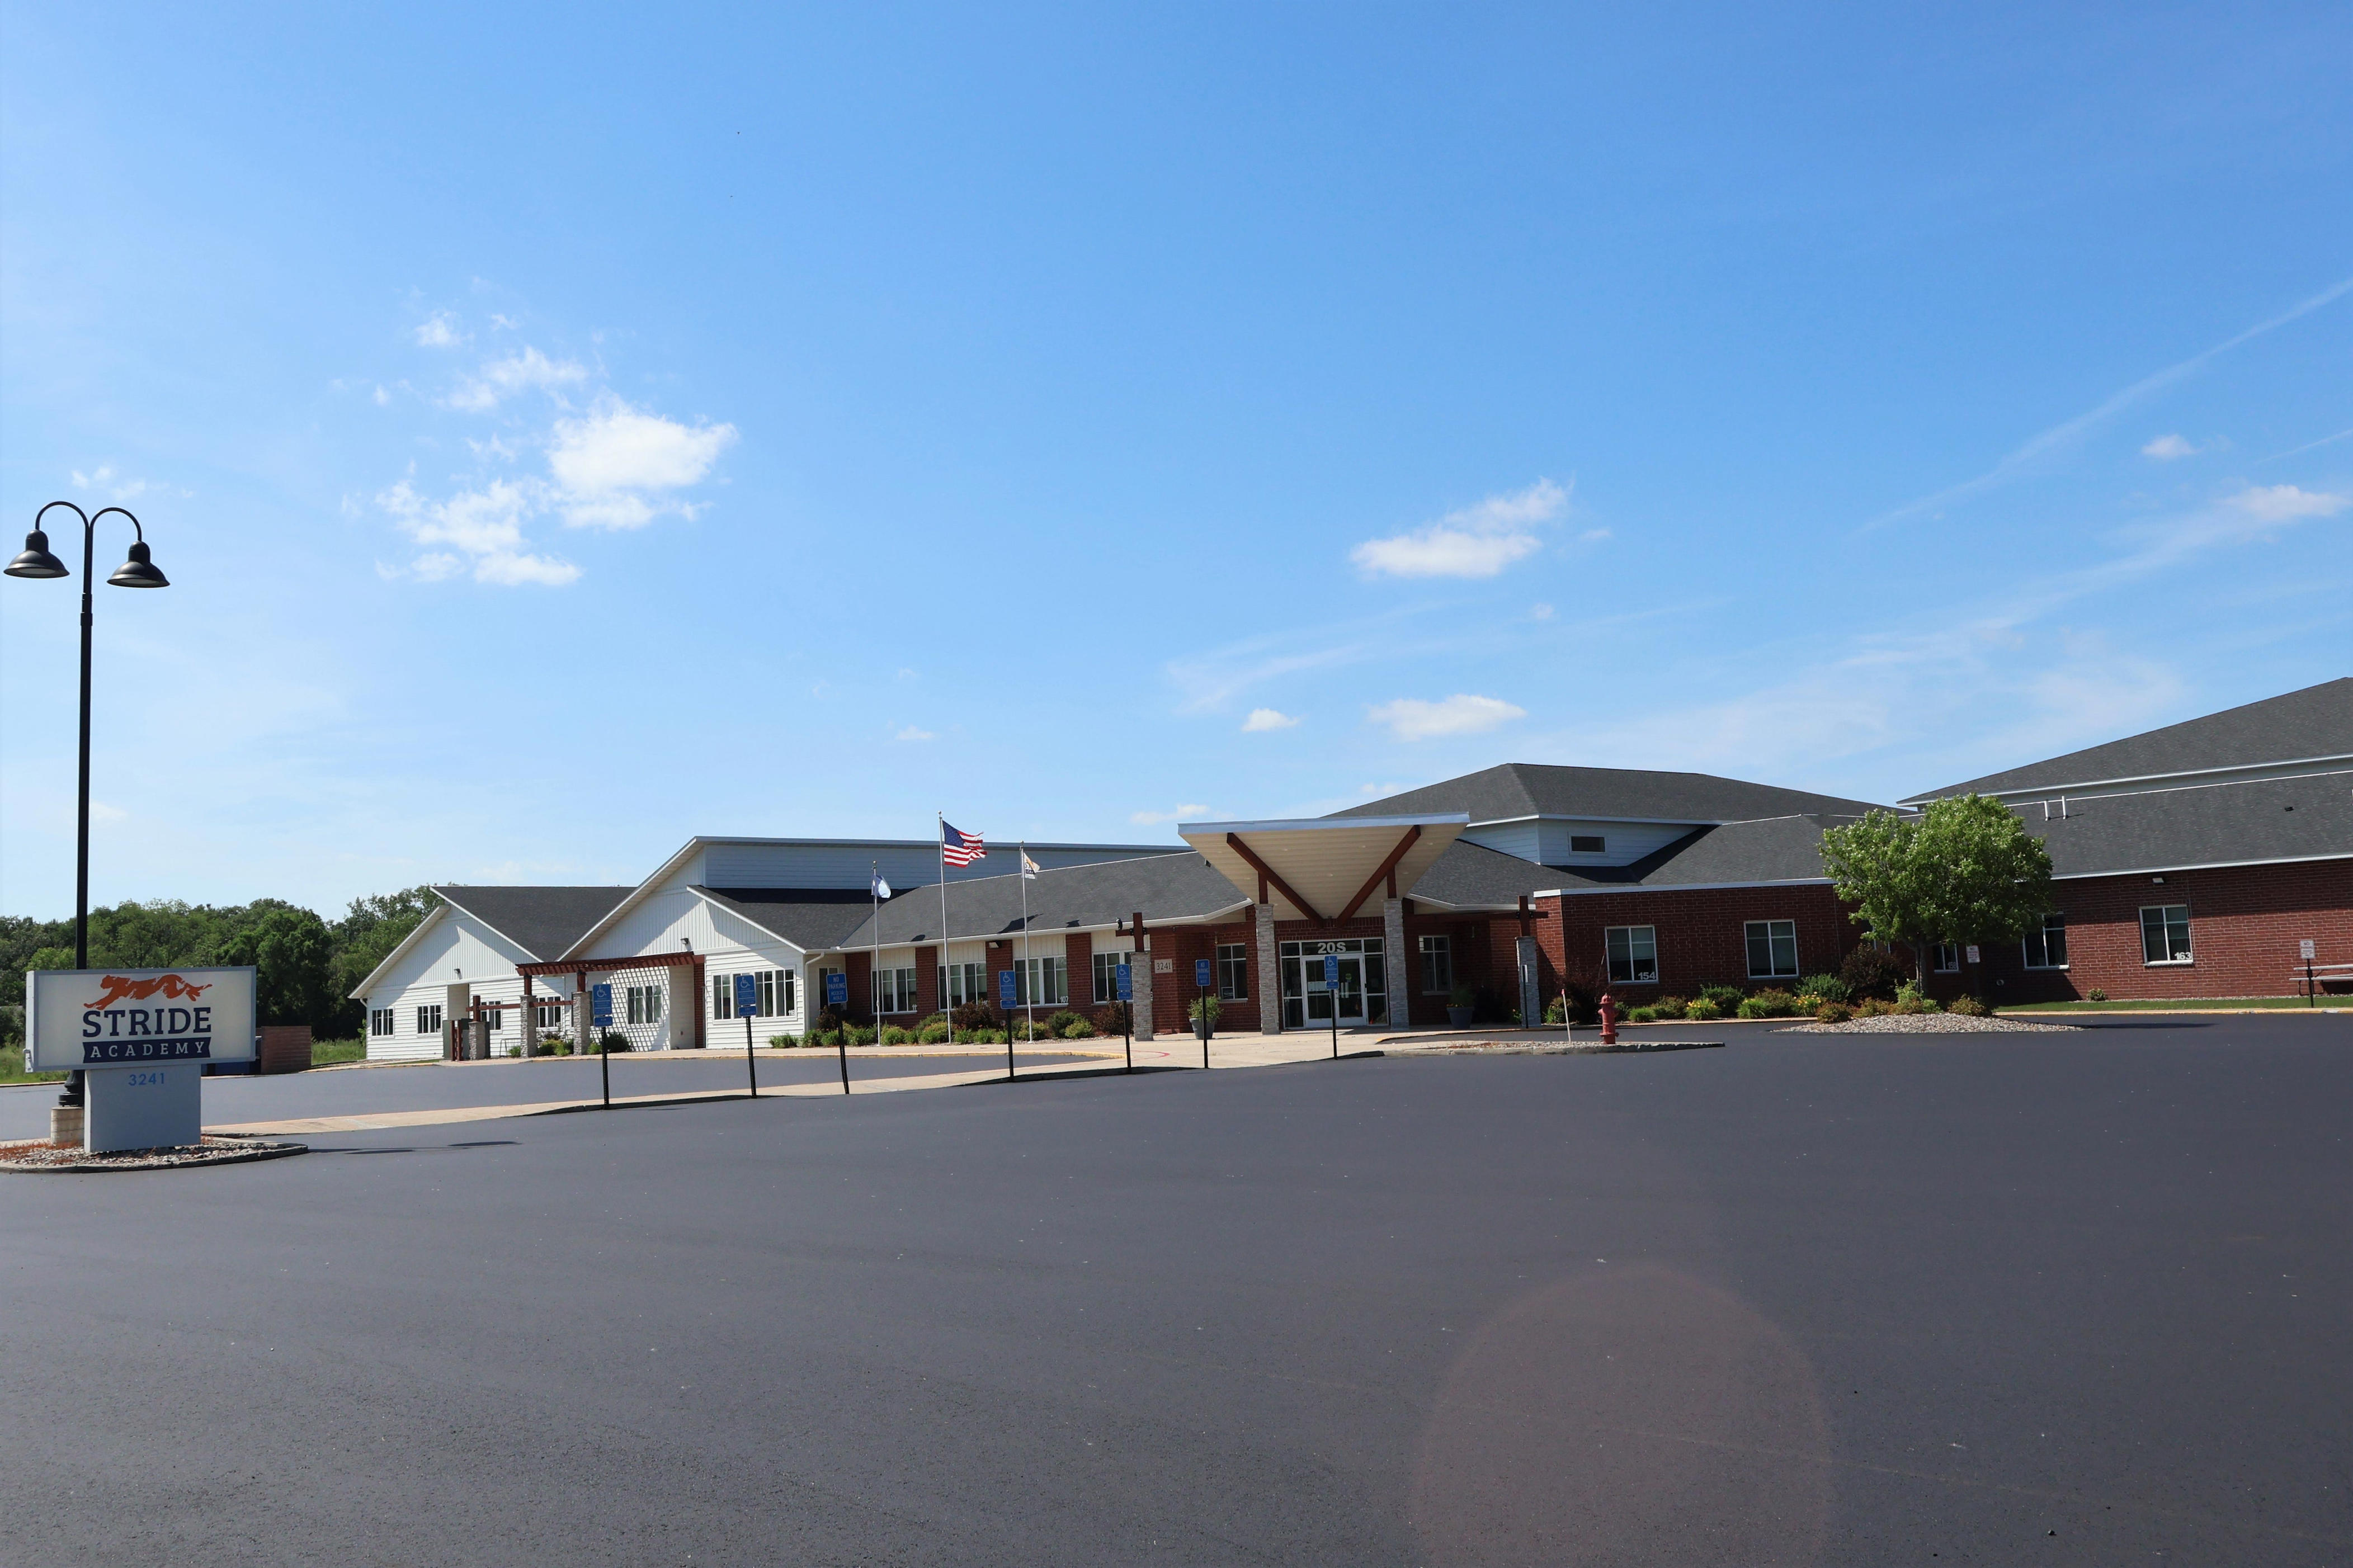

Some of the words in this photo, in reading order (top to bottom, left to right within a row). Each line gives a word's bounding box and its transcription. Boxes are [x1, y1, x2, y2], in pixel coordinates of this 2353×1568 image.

[1317, 942, 1346, 954] 20S
[2174, 952, 2191, 960] 163
[1157, 962, 1171, 970] 3241
[1638, 971, 1656, 980] 154
[83, 1007, 211, 1038] STRIDE
[90, 1041, 205, 1058] ACADEMY
[128, 1073, 164, 1087] 3241
